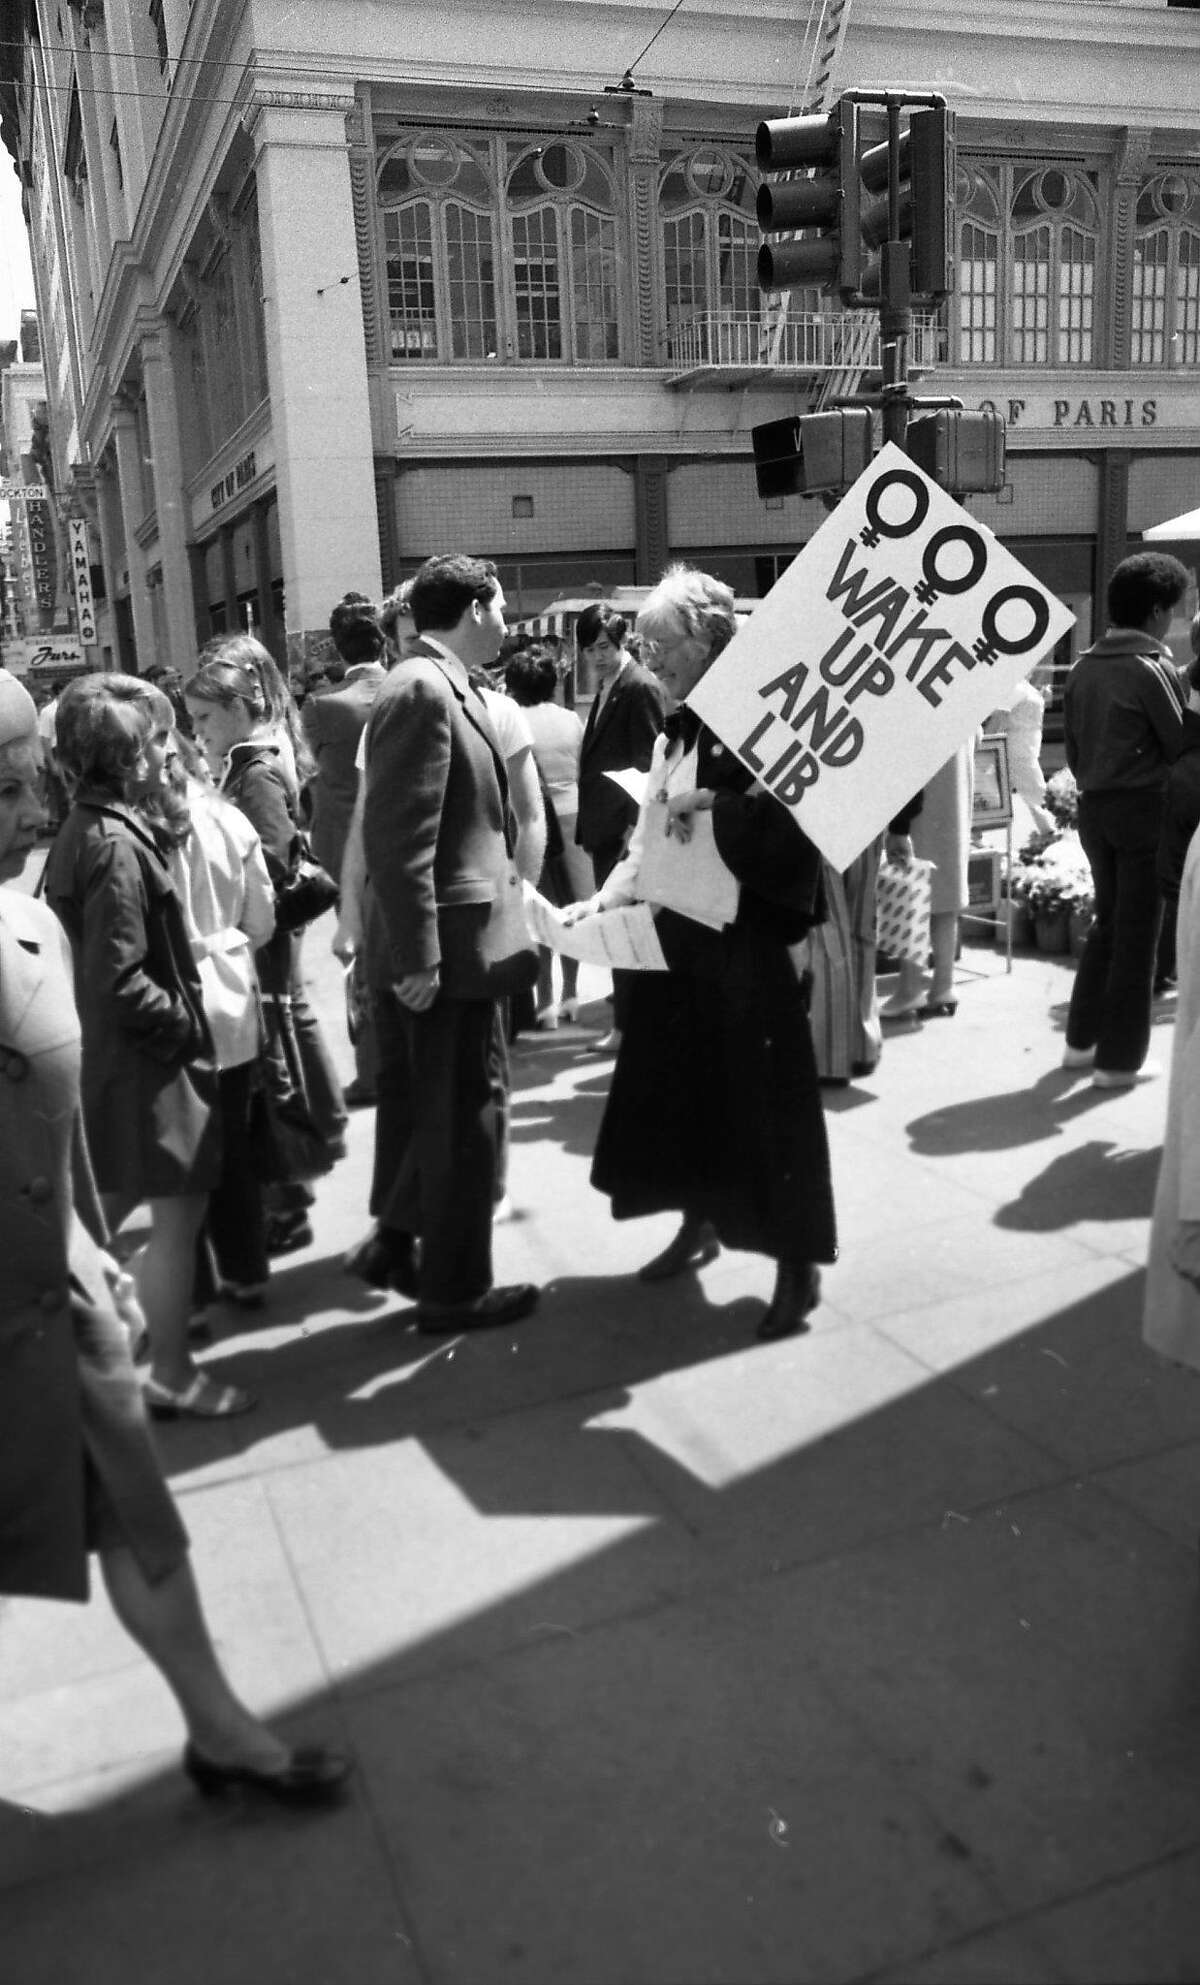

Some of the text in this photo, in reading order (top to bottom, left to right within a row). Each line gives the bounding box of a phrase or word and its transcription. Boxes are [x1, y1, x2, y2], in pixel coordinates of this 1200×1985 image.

[1053, 400, 1156, 426] PARIS
[72, 522, 92, 620] YAMAHA
[819, 626, 895, 704] UP
[826, 538, 977, 708] WAKE
[737, 711, 820, 806] LIB
[758, 661, 864, 767] AND
